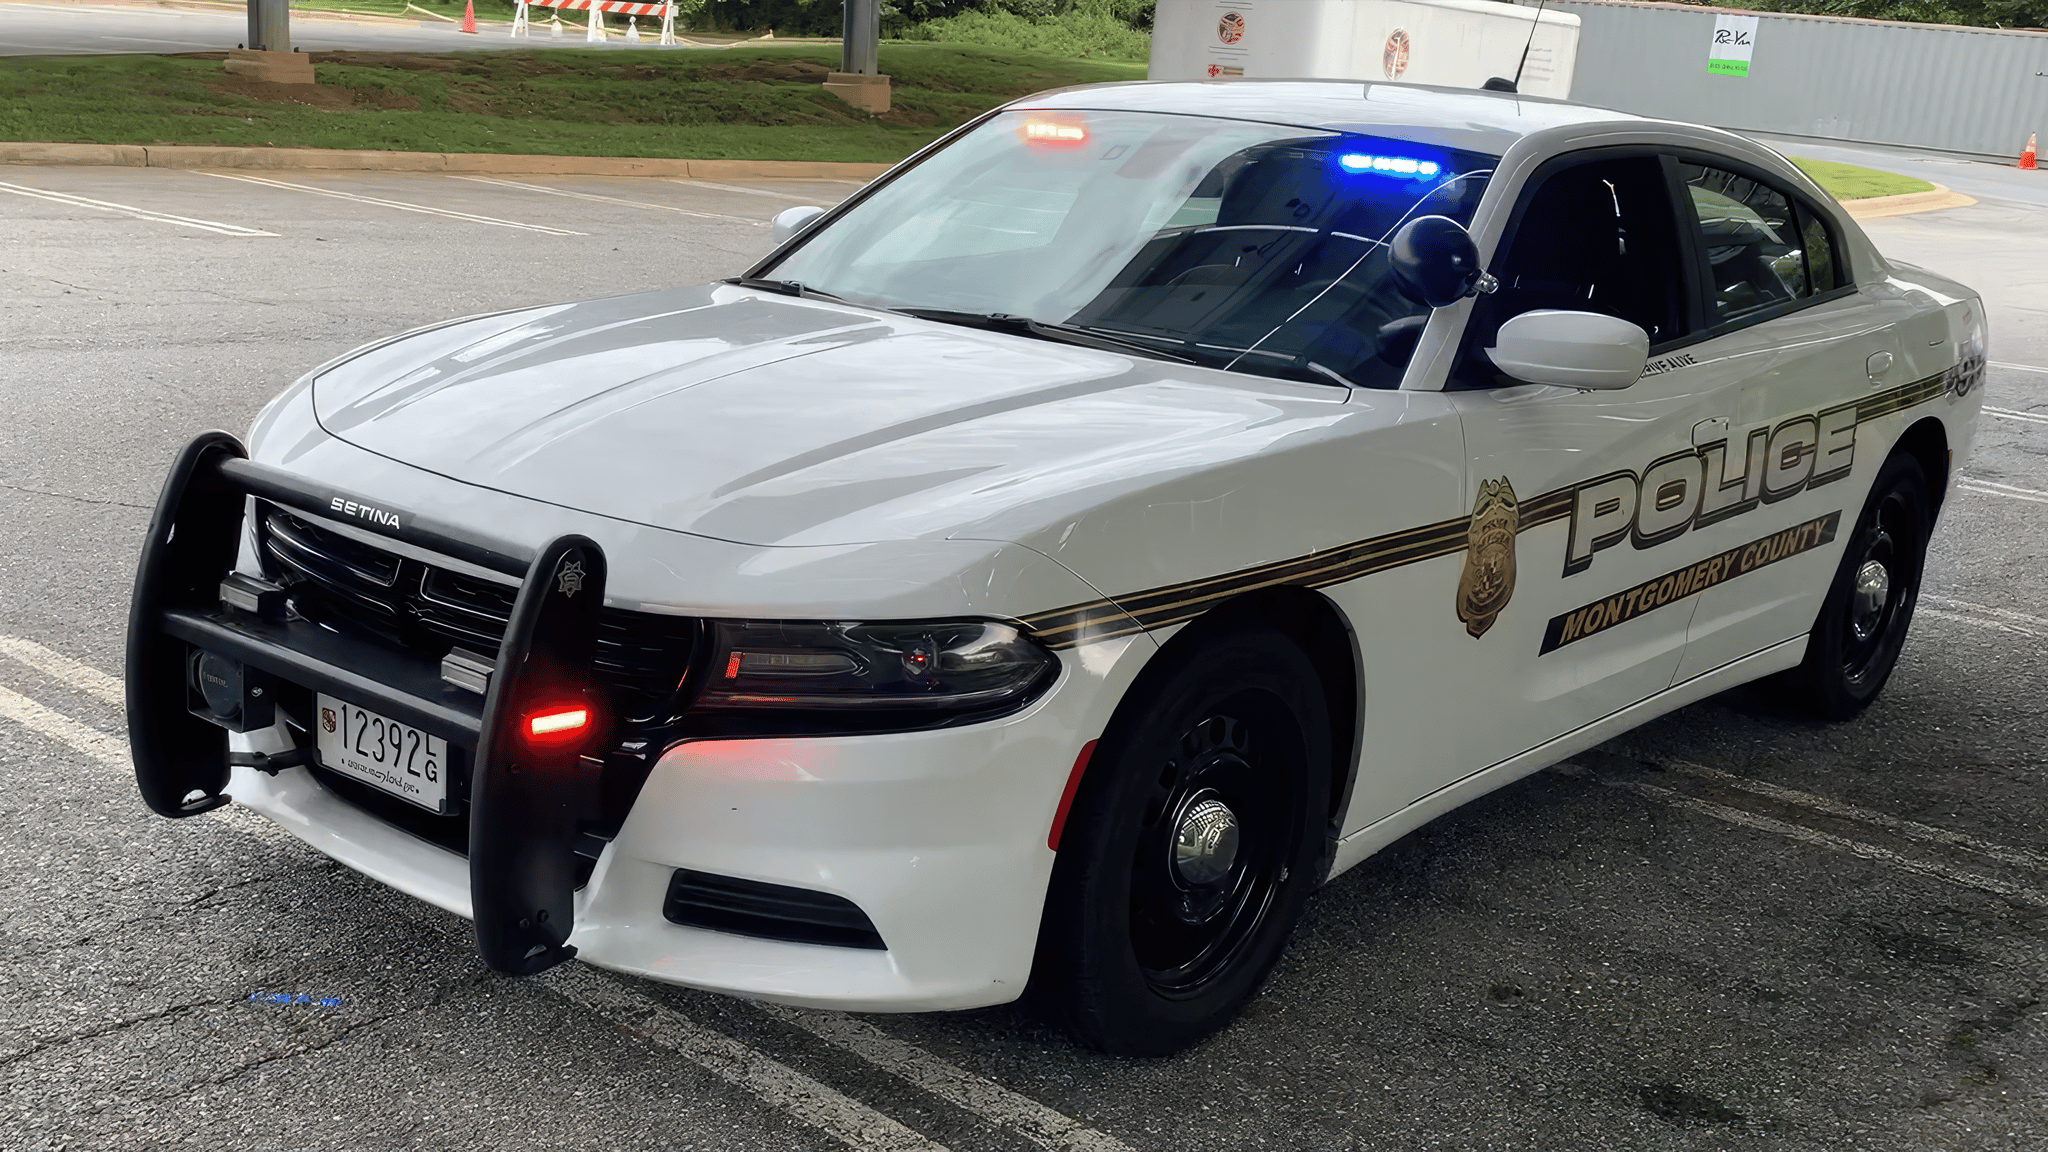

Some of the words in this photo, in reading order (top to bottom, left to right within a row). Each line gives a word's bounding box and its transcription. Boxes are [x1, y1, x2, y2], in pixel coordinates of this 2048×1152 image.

[330, 497, 400, 530] SETINA
[1562, 406, 1858, 579] POLICE
[1559, 552, 1738, 646] MONTGOMERY
[1739, 517, 1829, 573] COUNTY
[341, 703, 421, 778] 12392
